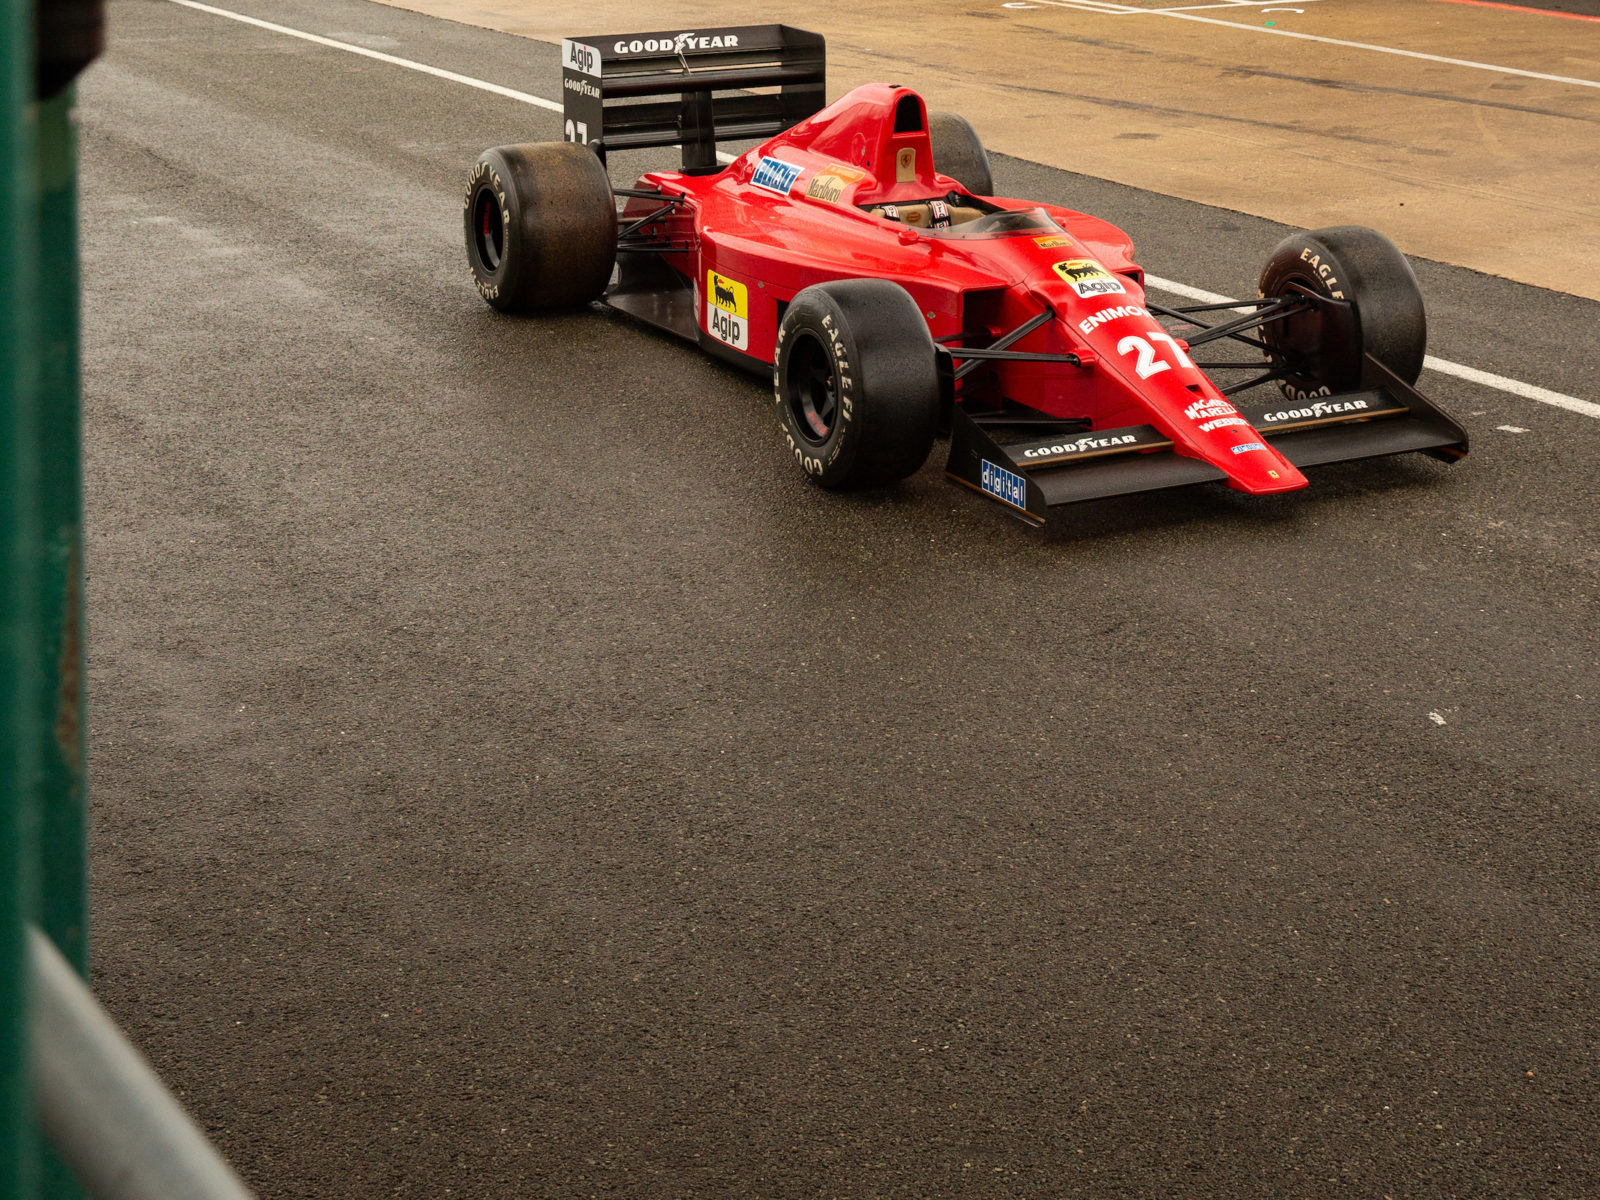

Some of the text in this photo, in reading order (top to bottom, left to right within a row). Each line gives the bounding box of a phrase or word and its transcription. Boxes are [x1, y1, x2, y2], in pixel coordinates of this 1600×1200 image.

[570, 42, 594, 73] Agip
[753, 160, 799, 191] FIAT
[806, 178, 842, 203] Marlboro
[1078, 280, 1121, 295] Agip
[712, 308, 741, 345] Agip
[1117, 331, 1195, 380] 27
[981, 467, 1025, 503] digital
